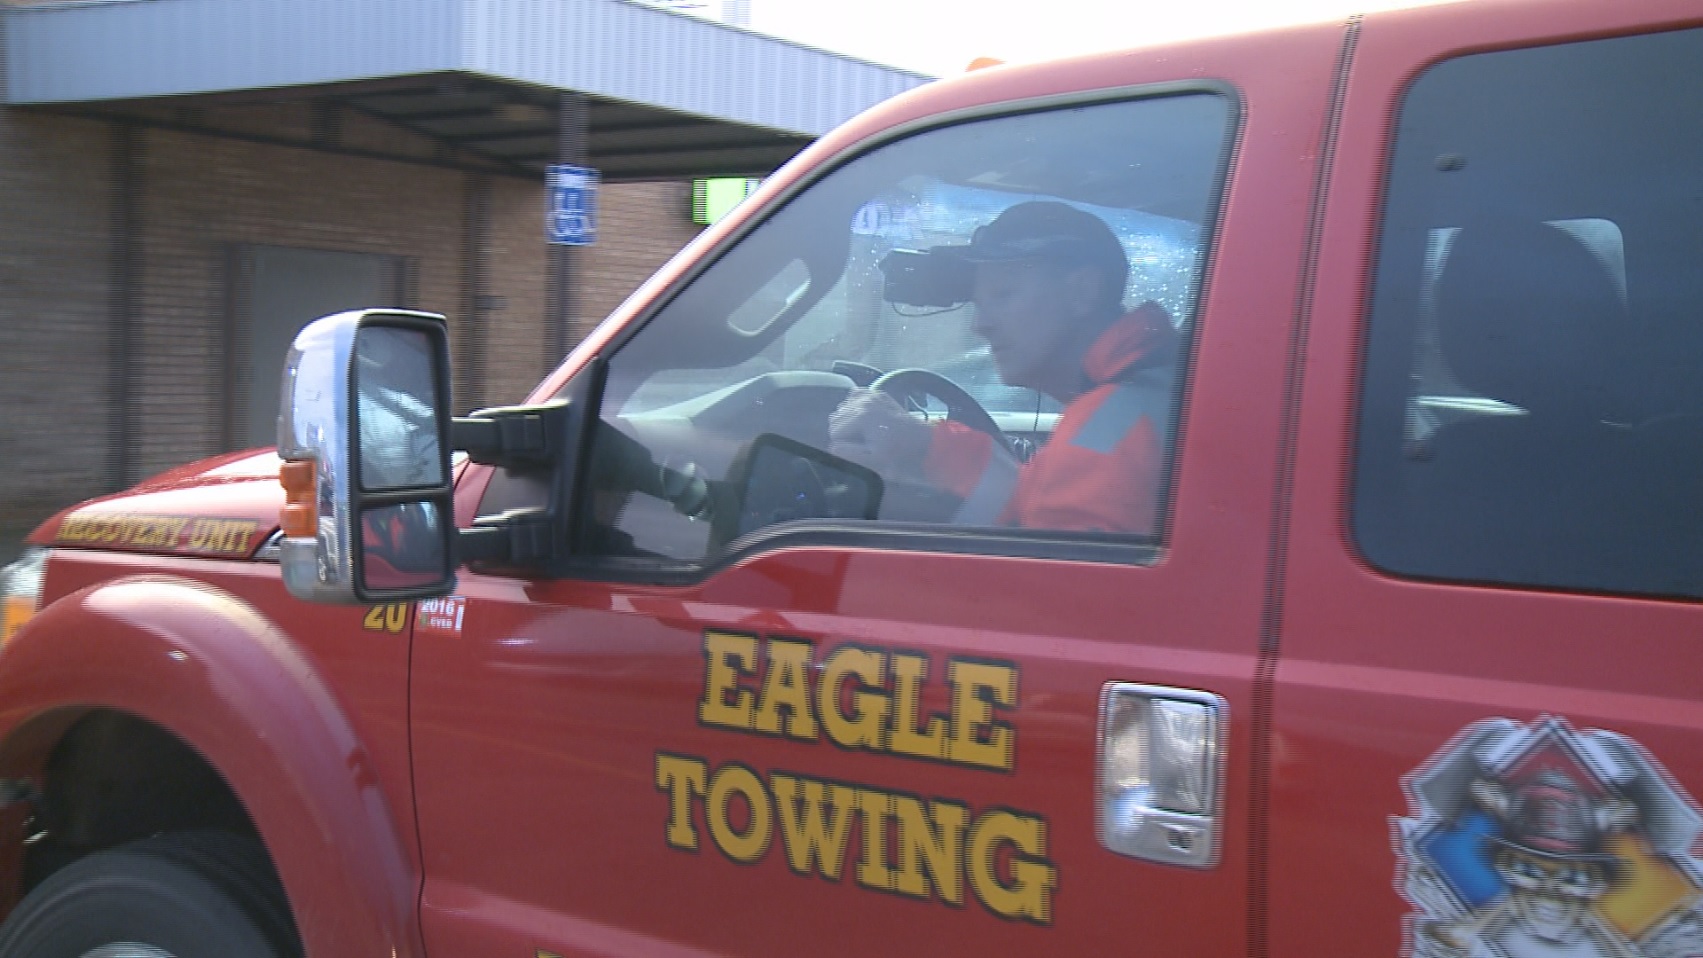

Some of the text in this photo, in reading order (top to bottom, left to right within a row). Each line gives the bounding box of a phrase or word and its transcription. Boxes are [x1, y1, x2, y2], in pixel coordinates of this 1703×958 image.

[57, 513, 258, 553] RECOVERY UNIT
[420, 598, 455, 616] 2016
[700, 629, 1018, 772] EAGLE
[656, 751, 1057, 925] TOWING
